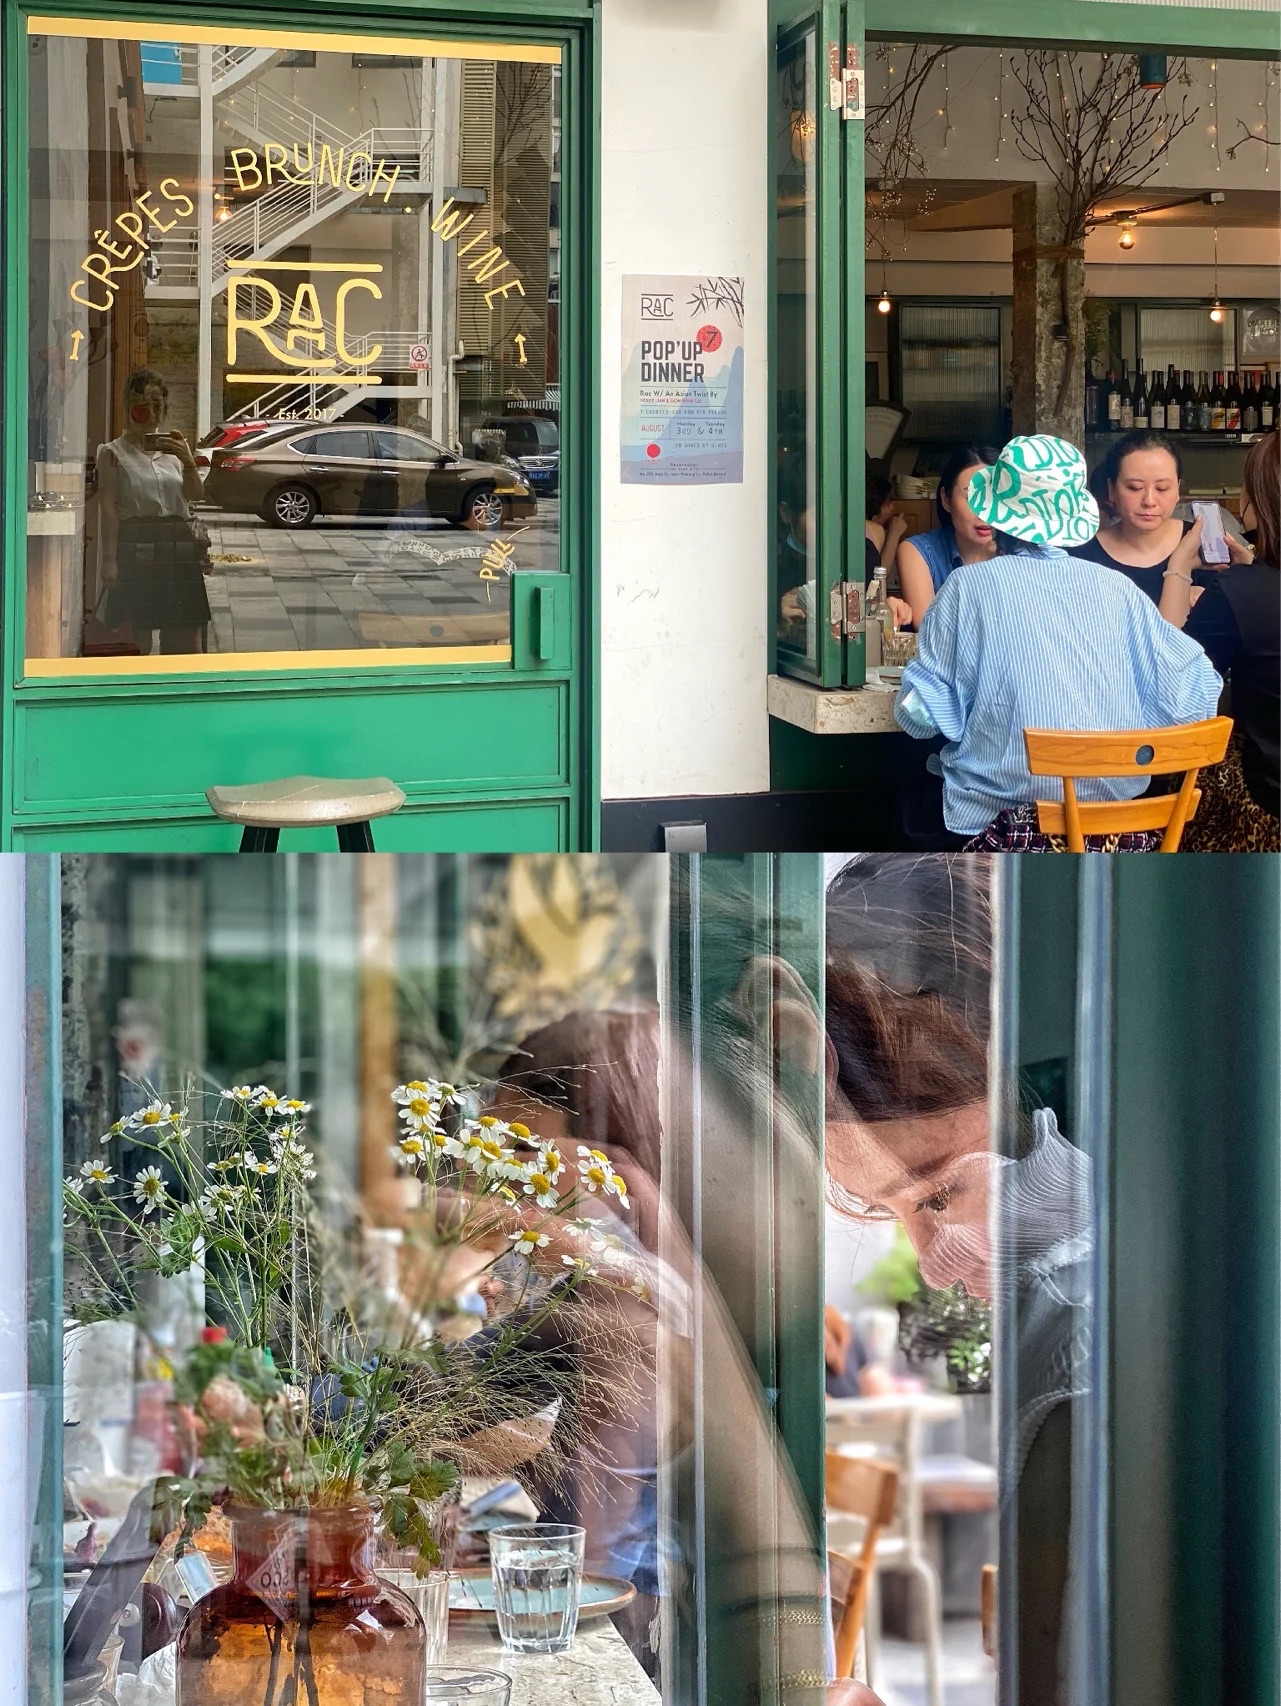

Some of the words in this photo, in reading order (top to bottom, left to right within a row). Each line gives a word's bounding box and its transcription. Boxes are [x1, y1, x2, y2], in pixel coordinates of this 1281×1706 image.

[70, 178, 194, 311] CRÊPES
[231, 143, 401, 203] BRUNCH
[430, 196, 526, 310] WINE
[641, 297, 674, 317] RAC
[227, 277, 383, 368] RAC
[706, 331, 719, 348] 7
[641, 340, 703, 361] POP'UP
[641, 362, 705, 383] DINNER
[279, 408, 299, 420] Est.
[304, 408, 337, 420] 2017
[641, 424, 665, 432] AUGUST
[479, 538, 516, 581] PULL
